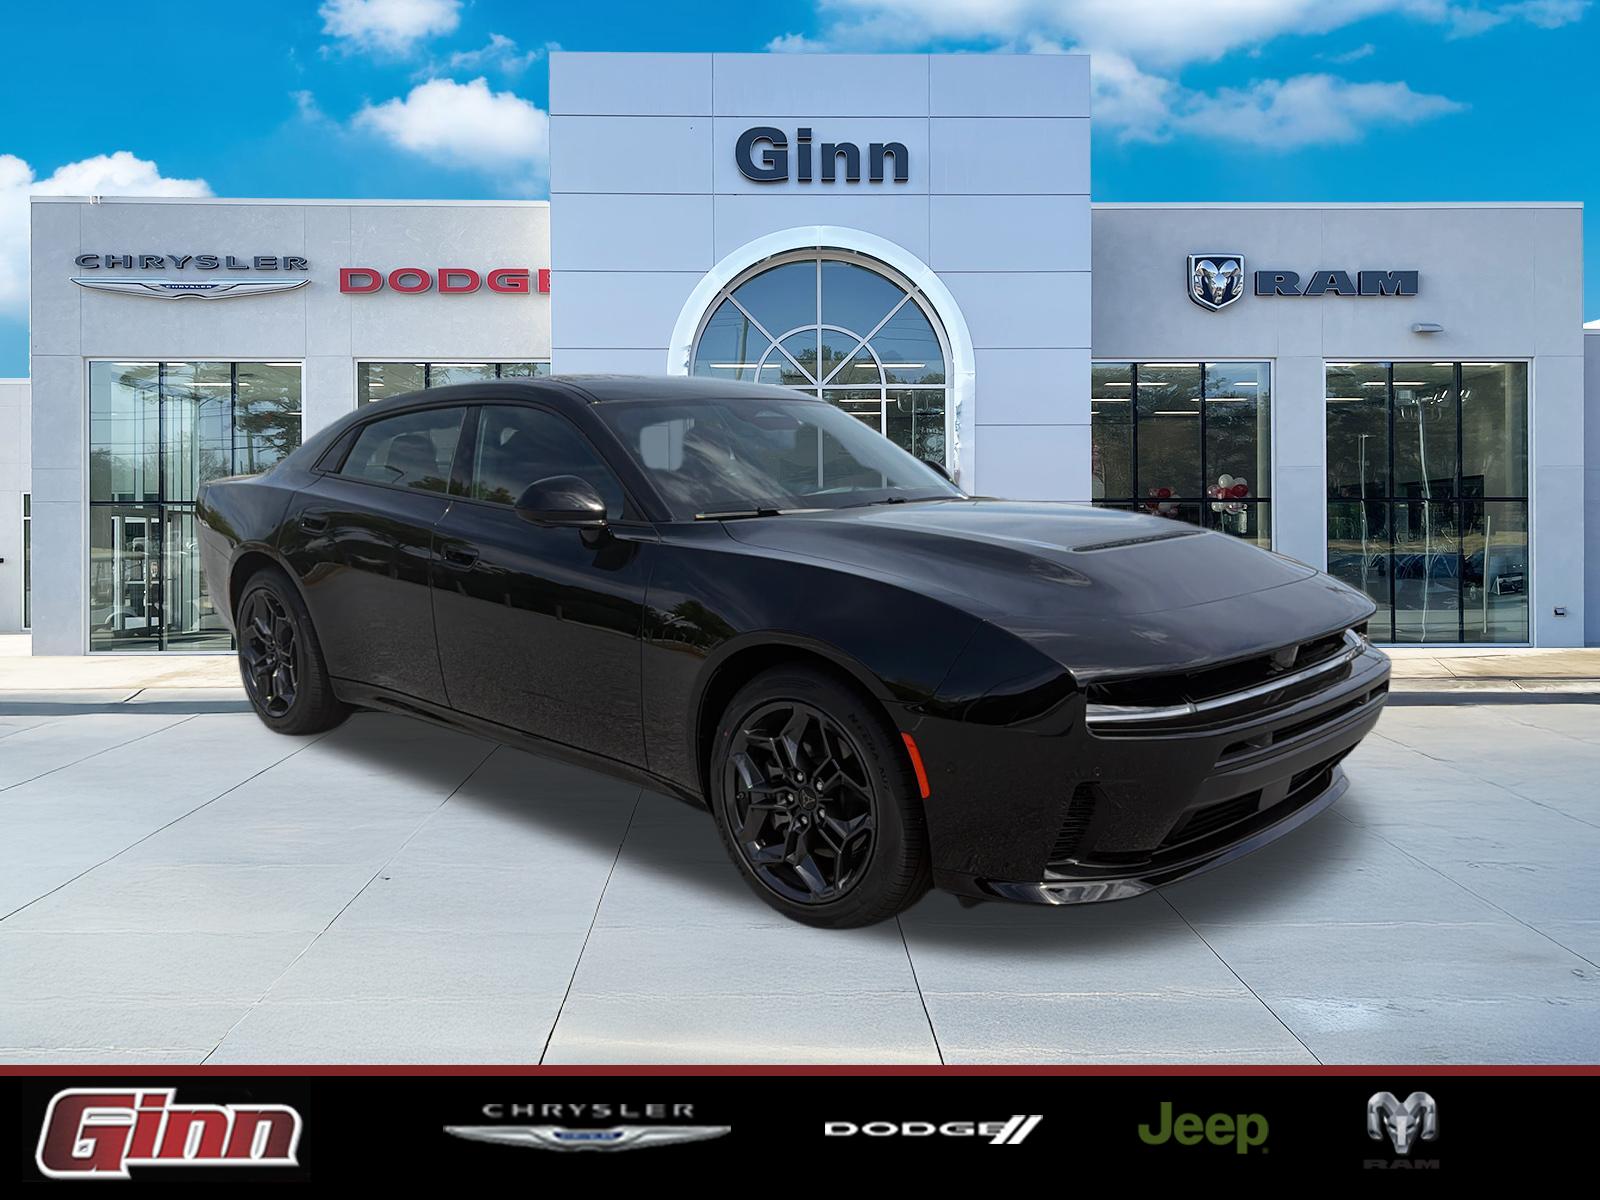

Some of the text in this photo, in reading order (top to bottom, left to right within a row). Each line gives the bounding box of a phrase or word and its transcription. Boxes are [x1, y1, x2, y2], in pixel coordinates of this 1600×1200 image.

[735, 126, 909, 183] Ginn
[74, 254, 309, 271] CHRYSLER
[1254, 270, 1419, 297] RAM
